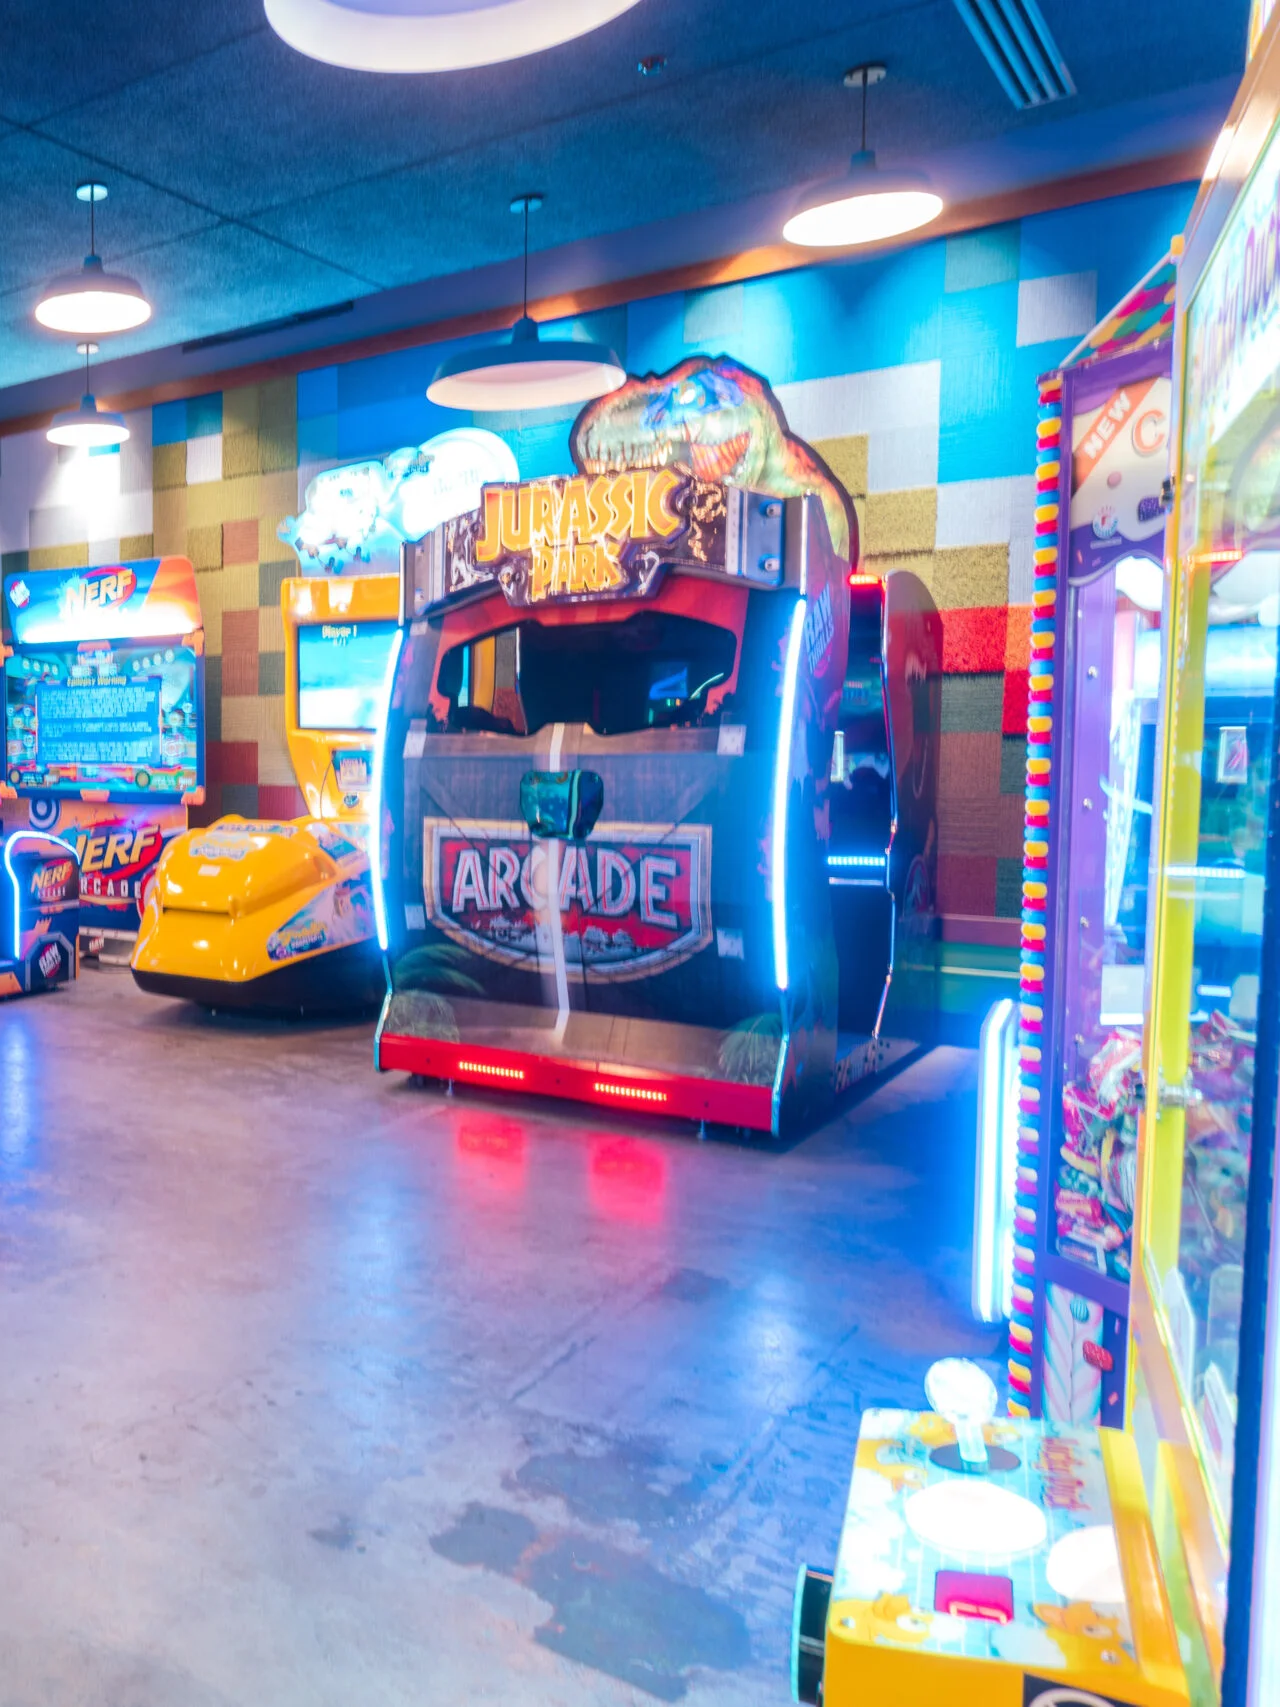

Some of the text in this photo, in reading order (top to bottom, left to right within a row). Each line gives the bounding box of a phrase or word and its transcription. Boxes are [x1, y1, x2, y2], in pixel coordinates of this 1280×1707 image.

[1084, 390, 1132, 459] NEW
[476, 469, 680, 562] JURASSIC
[63, 568, 133, 614] NERF
[531, 541, 621, 602] PARK
[31, 860, 72, 894] NERF
[80, 877, 142, 899] RCADE
[452, 846, 678, 928] ARCADE
